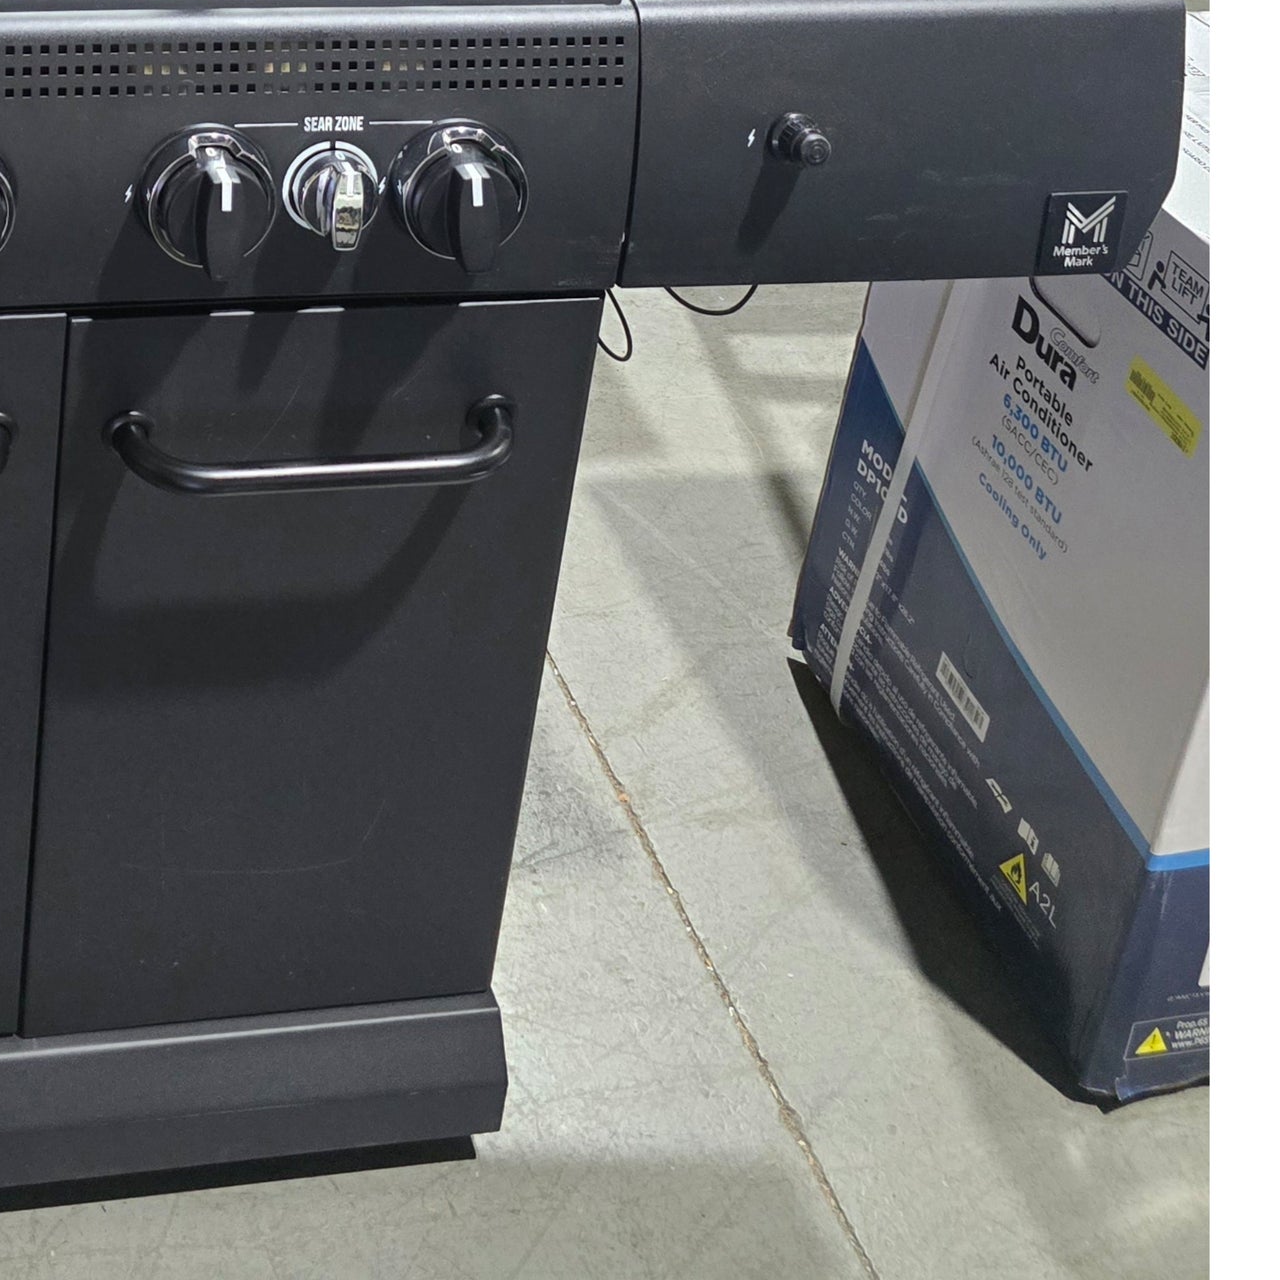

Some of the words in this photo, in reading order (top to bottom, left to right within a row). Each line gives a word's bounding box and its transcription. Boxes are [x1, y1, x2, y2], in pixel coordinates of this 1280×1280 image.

[303, 116, 333, 132] SEAR
[335, 116, 364, 131] ZONE
[1053, 244, 1109, 257] Member's
[1064, 257, 1093, 267] Mark
[1172, 261, 1204, 299] TEAM
[1128, 281, 1165, 325] THIS
[1167, 319, 1208, 368] SIDE
[1172, 282, 1197, 305] LIFT
[1012, 294, 1077, 391] Dura
[1050, 327, 1100, 384] Comfort
[989, 354, 1010, 380] Air
[1013, 377, 1094, 472] Conditioner
[1016, 355, 1073, 427] Portable
[1001, 415, 1059, 486] (SACC/CEC)
[1003, 393, 1039, 440] 6,300
[1040, 435, 1068, 472] BTU
[992, 434, 1033, 491] 10,000
[1035, 486, 1062, 524] BTU
[978, 472, 1019, 528] Cooling
[1021, 524, 1047, 561] Only
[1029, 881, 1056, 930] A2L
